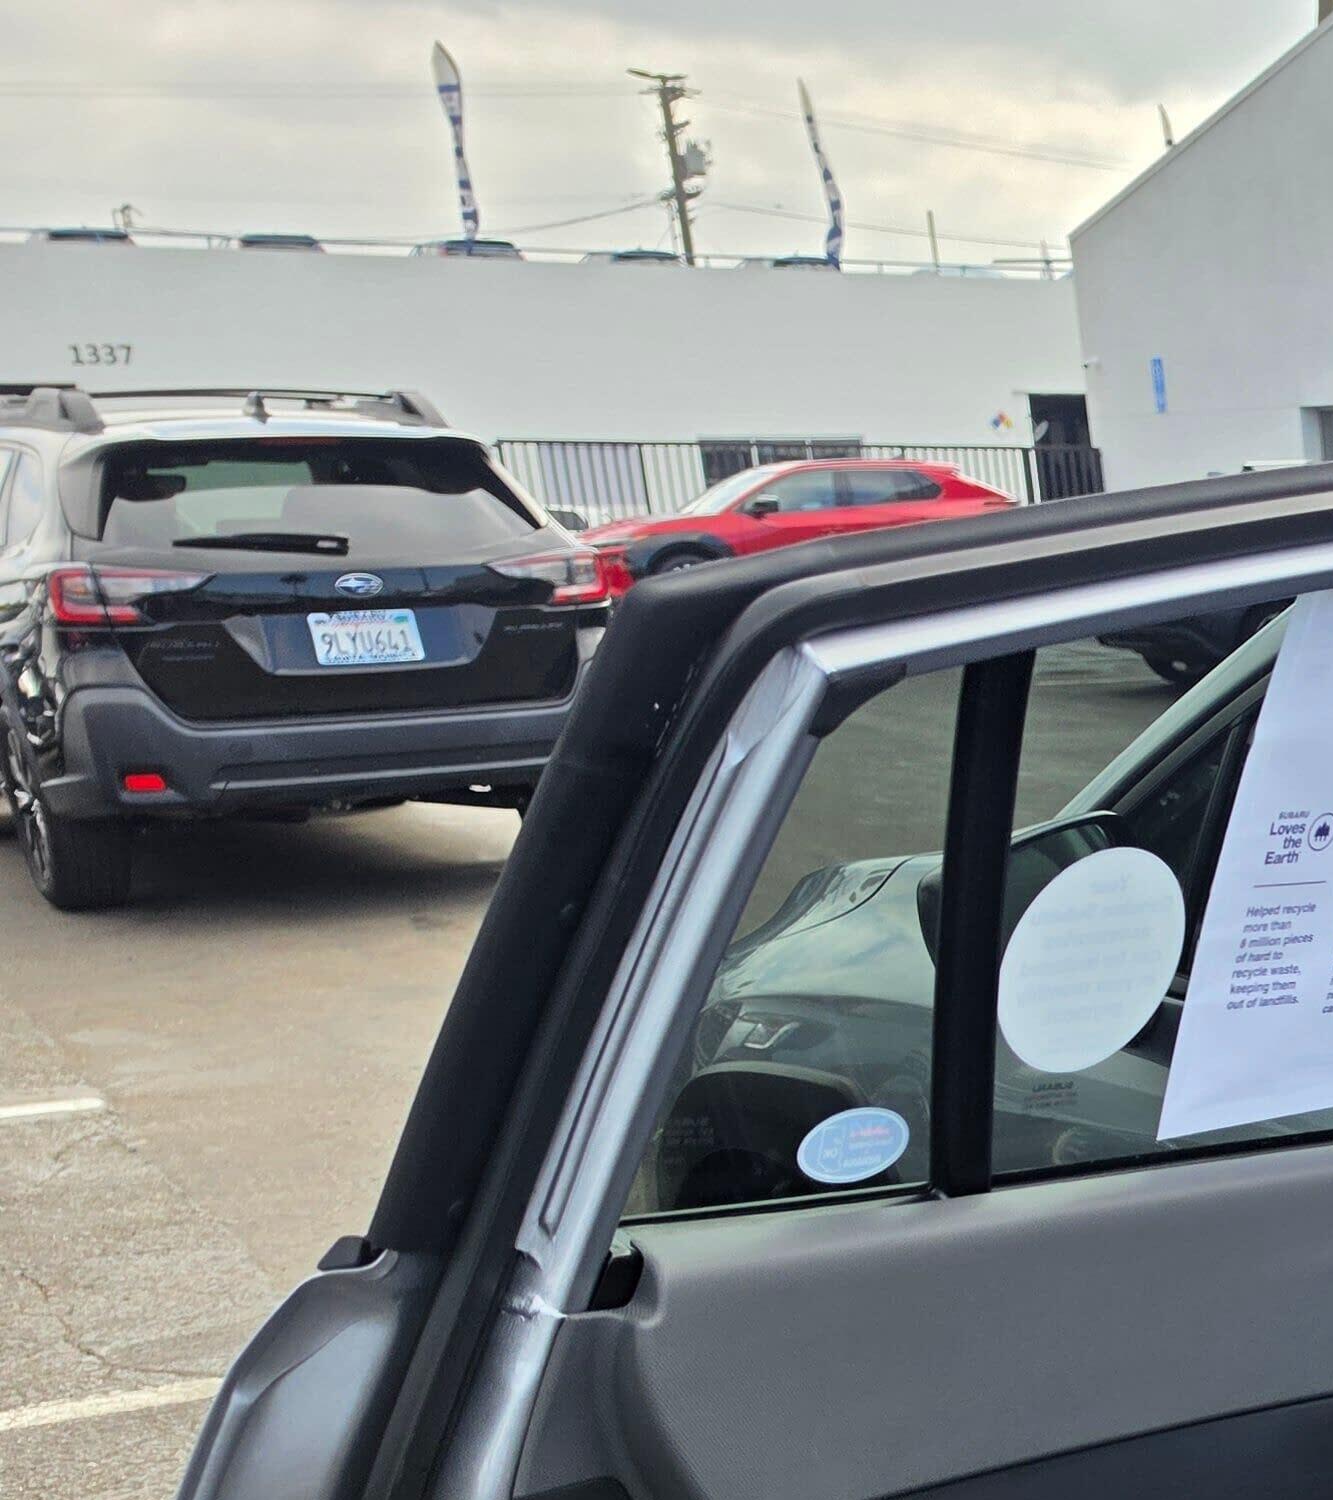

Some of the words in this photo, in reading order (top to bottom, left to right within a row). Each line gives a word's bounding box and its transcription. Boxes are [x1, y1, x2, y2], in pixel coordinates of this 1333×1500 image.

[68, 344, 131, 366] 1337
[1269, 823, 1306, 836] Loves
[1283, 837, 1302, 849] the
[1264, 851, 1299, 865] Earth
